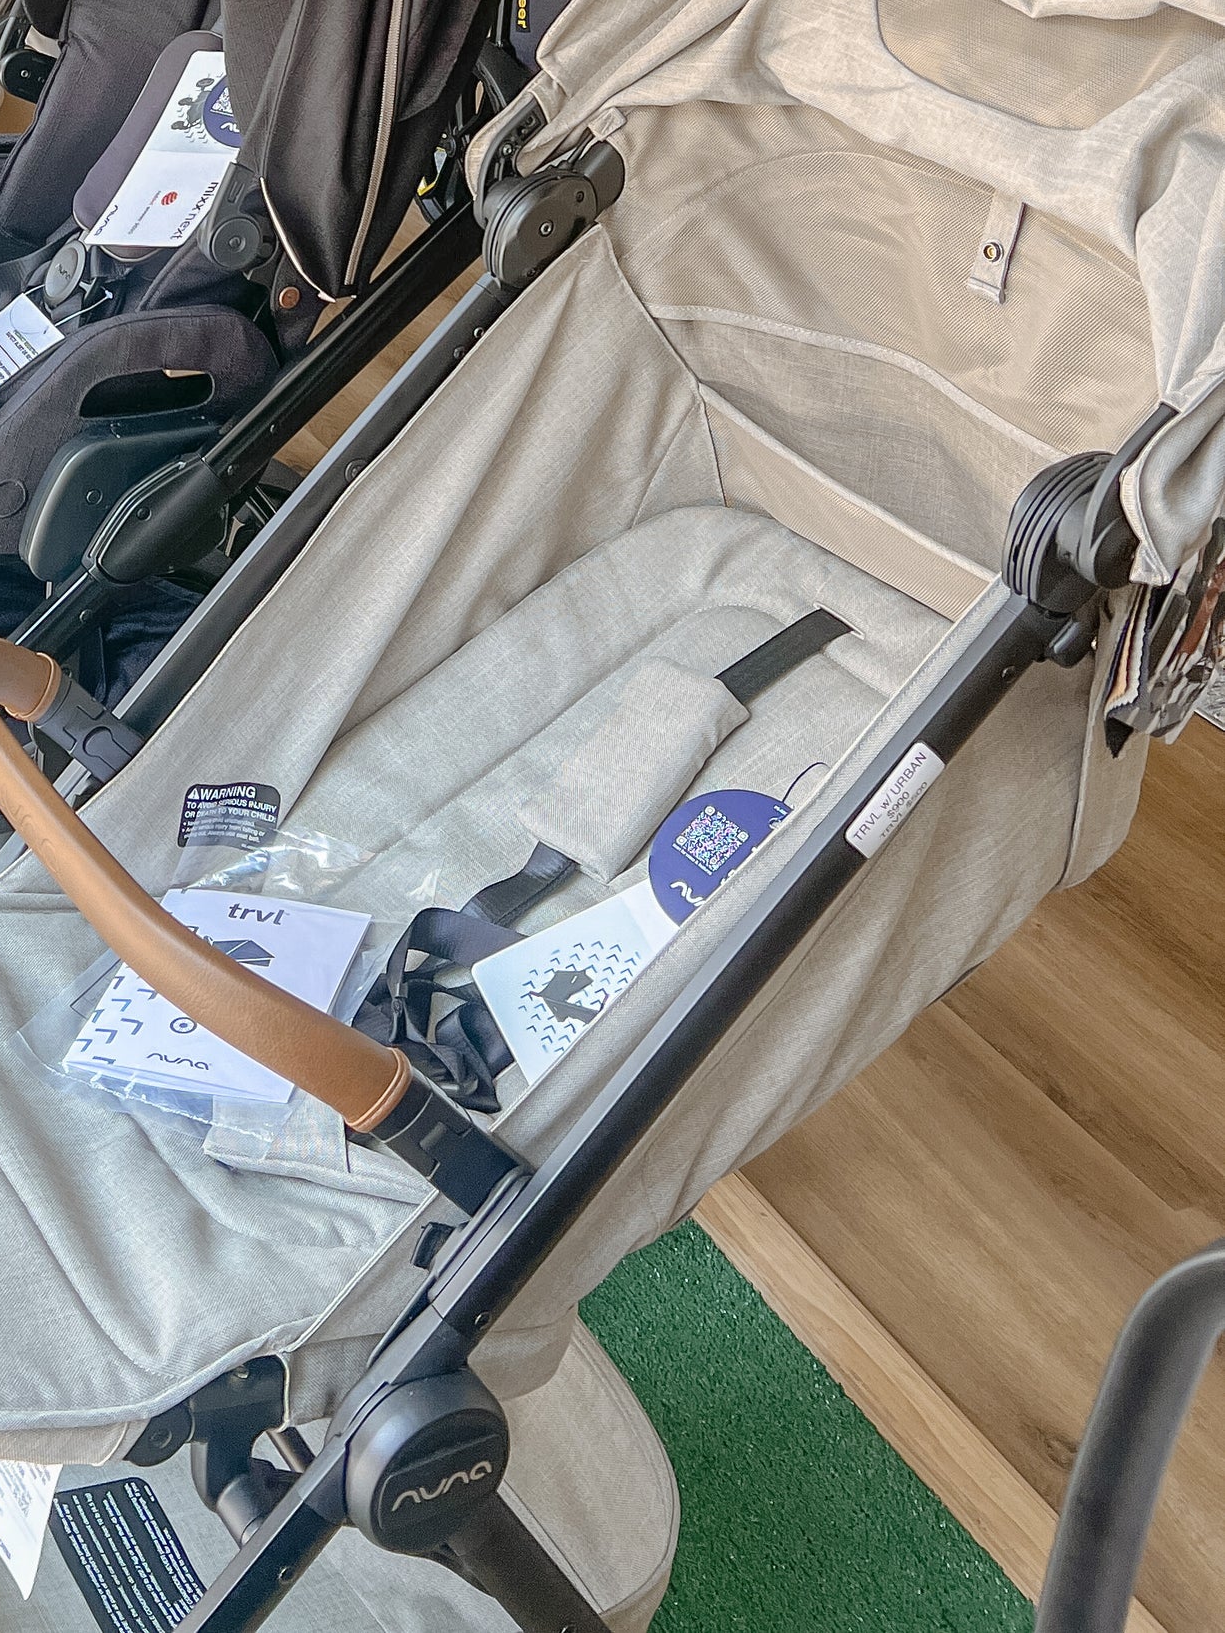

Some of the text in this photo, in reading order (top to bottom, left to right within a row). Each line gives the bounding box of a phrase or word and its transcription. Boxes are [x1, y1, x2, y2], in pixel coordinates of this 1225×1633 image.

[94, 204, 119, 237] nuna
[171, 181, 219, 241] mixx next
[200, 785, 256, 801] WARNING
[853, 751, 928, 841] TRVL w/ URBAN
[886, 791, 911, 819] $900
[186, 801, 196, 809] TO
[248, 801, 277, 813] INJURY
[228, 807, 250, 816] YOUR
[228, 902, 284, 928] trvl
[146, 1052, 212, 1072] nuna
[391, 1458, 493, 1513] nuna
